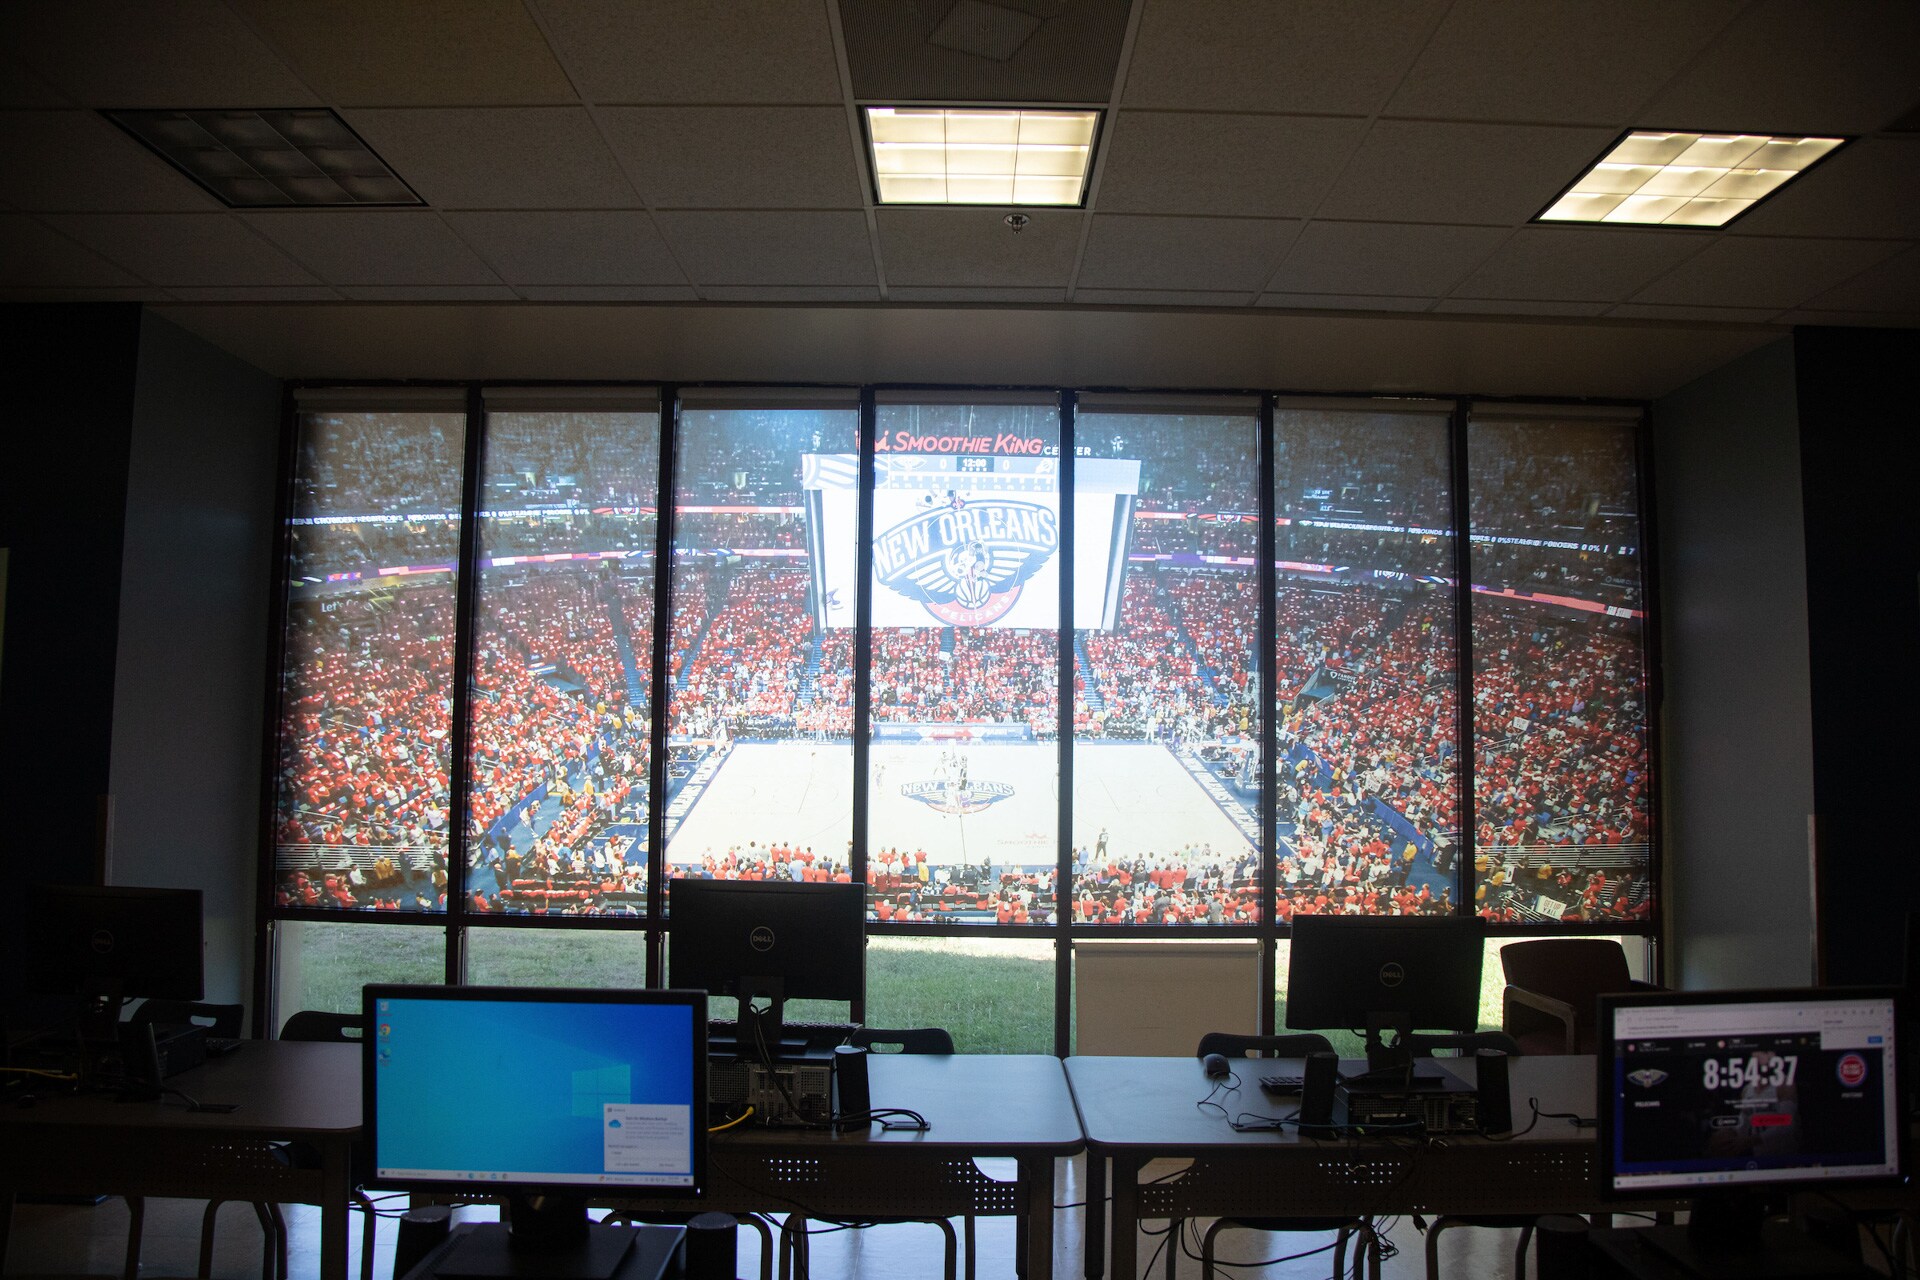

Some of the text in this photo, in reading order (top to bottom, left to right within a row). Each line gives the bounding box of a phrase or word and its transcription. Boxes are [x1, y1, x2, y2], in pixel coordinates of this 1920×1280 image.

[892, 431, 992, 453] SMOOTHIE
[1043, 446, 1091, 456] CEER
[872, 507, 1057, 580] NEW ORLEANS
[902, 782, 938, 795] NEW
[1703, 1056, 1798, 1090] 8:54:37
